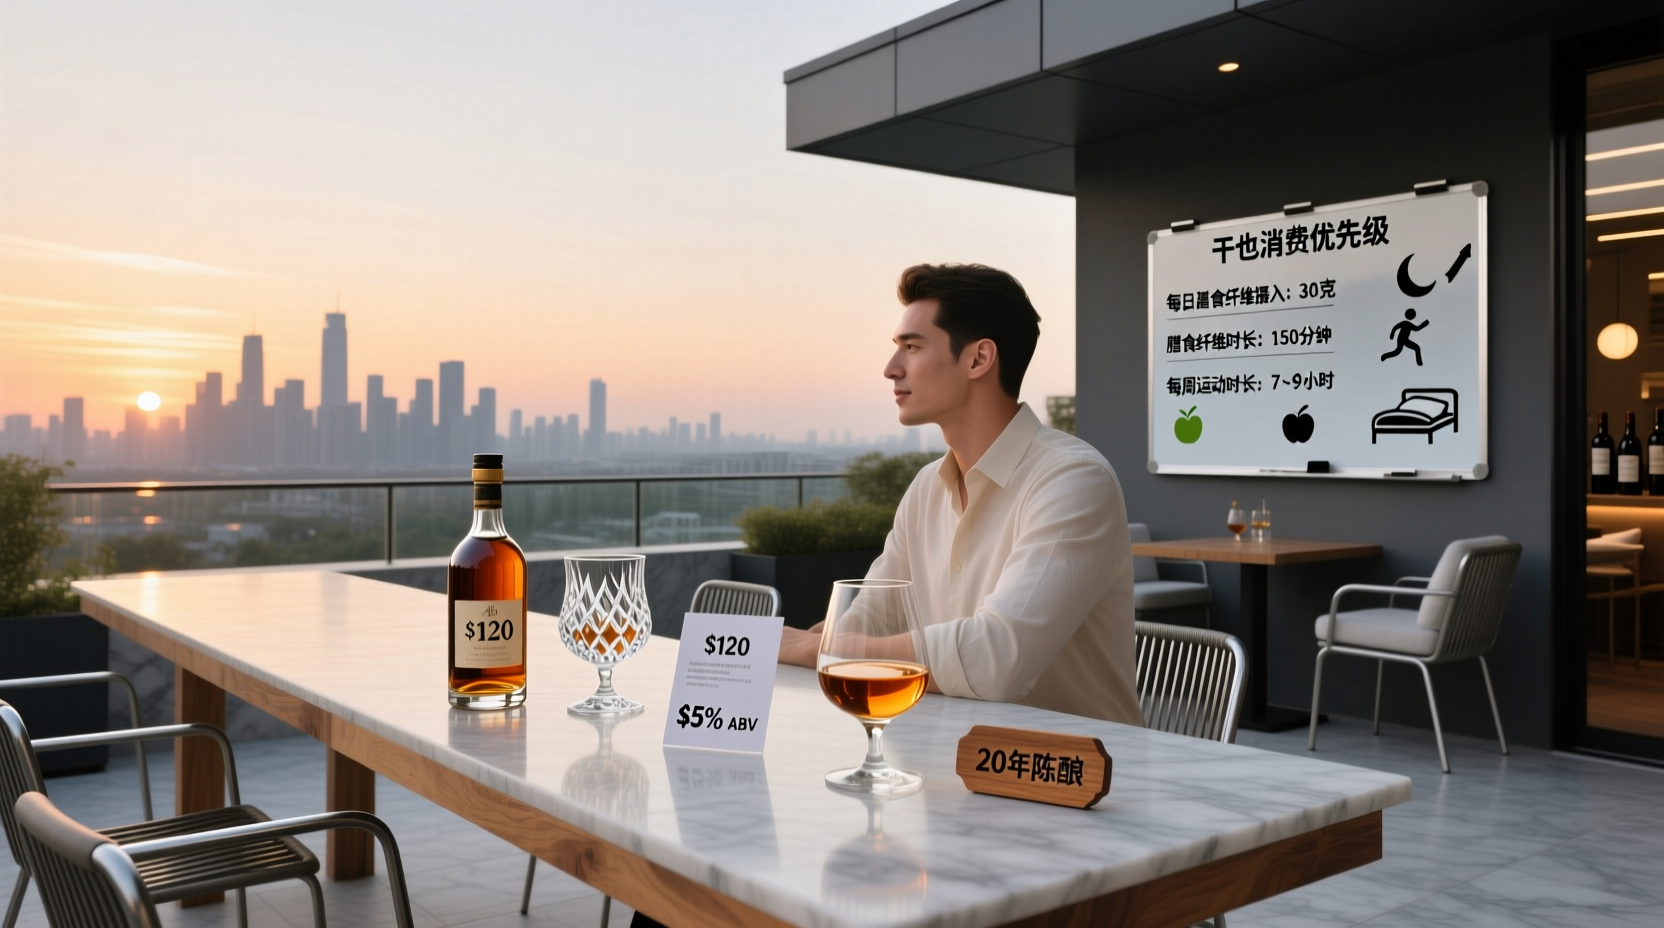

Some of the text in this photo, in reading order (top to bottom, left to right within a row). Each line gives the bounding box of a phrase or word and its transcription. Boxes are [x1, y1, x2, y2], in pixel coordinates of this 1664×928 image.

[1212, 216, 1390, 264] 干也消费优先级
[465, 620, 513, 641] $120
[705, 633, 751, 656] $120
[677, 704, 759, 732] $5% ABV
[975, 747, 1084, 787] 20年陈酿
